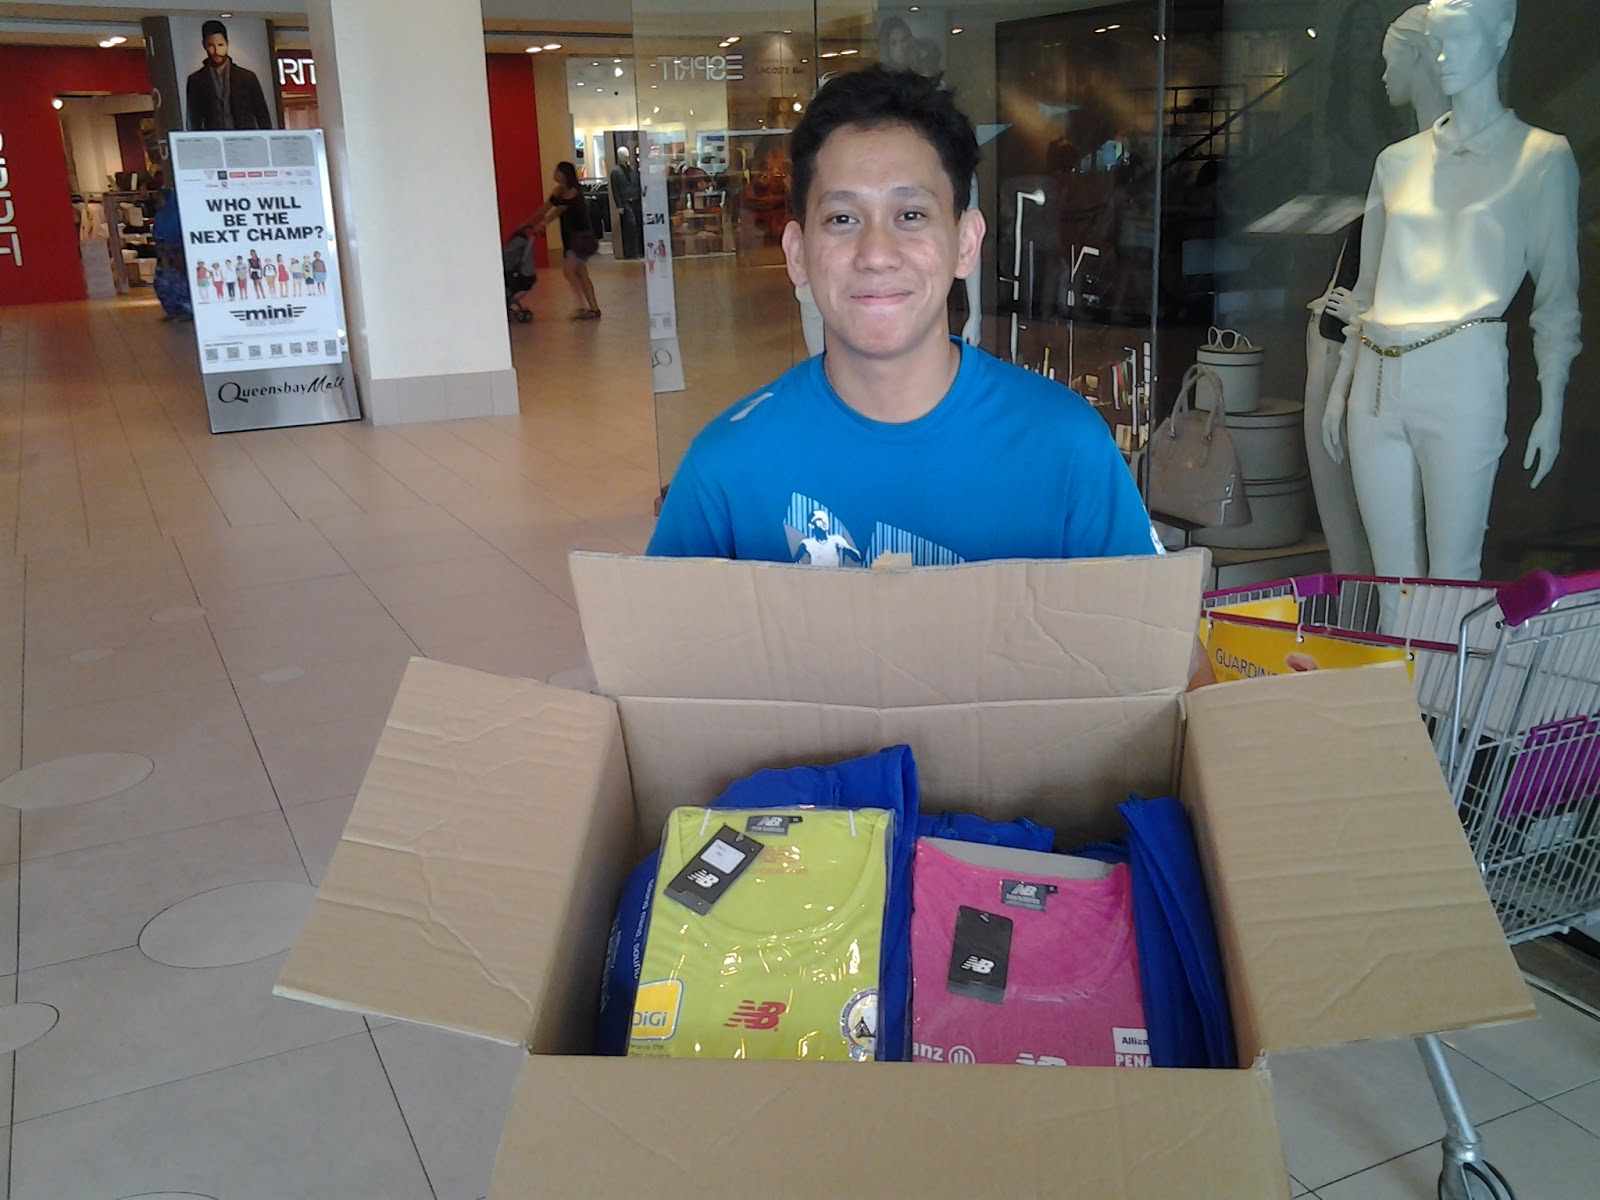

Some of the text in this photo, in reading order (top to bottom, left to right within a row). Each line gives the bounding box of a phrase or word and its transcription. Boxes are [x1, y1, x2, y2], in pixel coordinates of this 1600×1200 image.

[205, 196, 301, 212] WHO WILL
[223, 212, 289, 227] BE THE
[190, 225, 324, 244] NEXT CHAMP?
[245, 304, 293, 321] mini
[632, 1011, 667, 1027] DiGi
